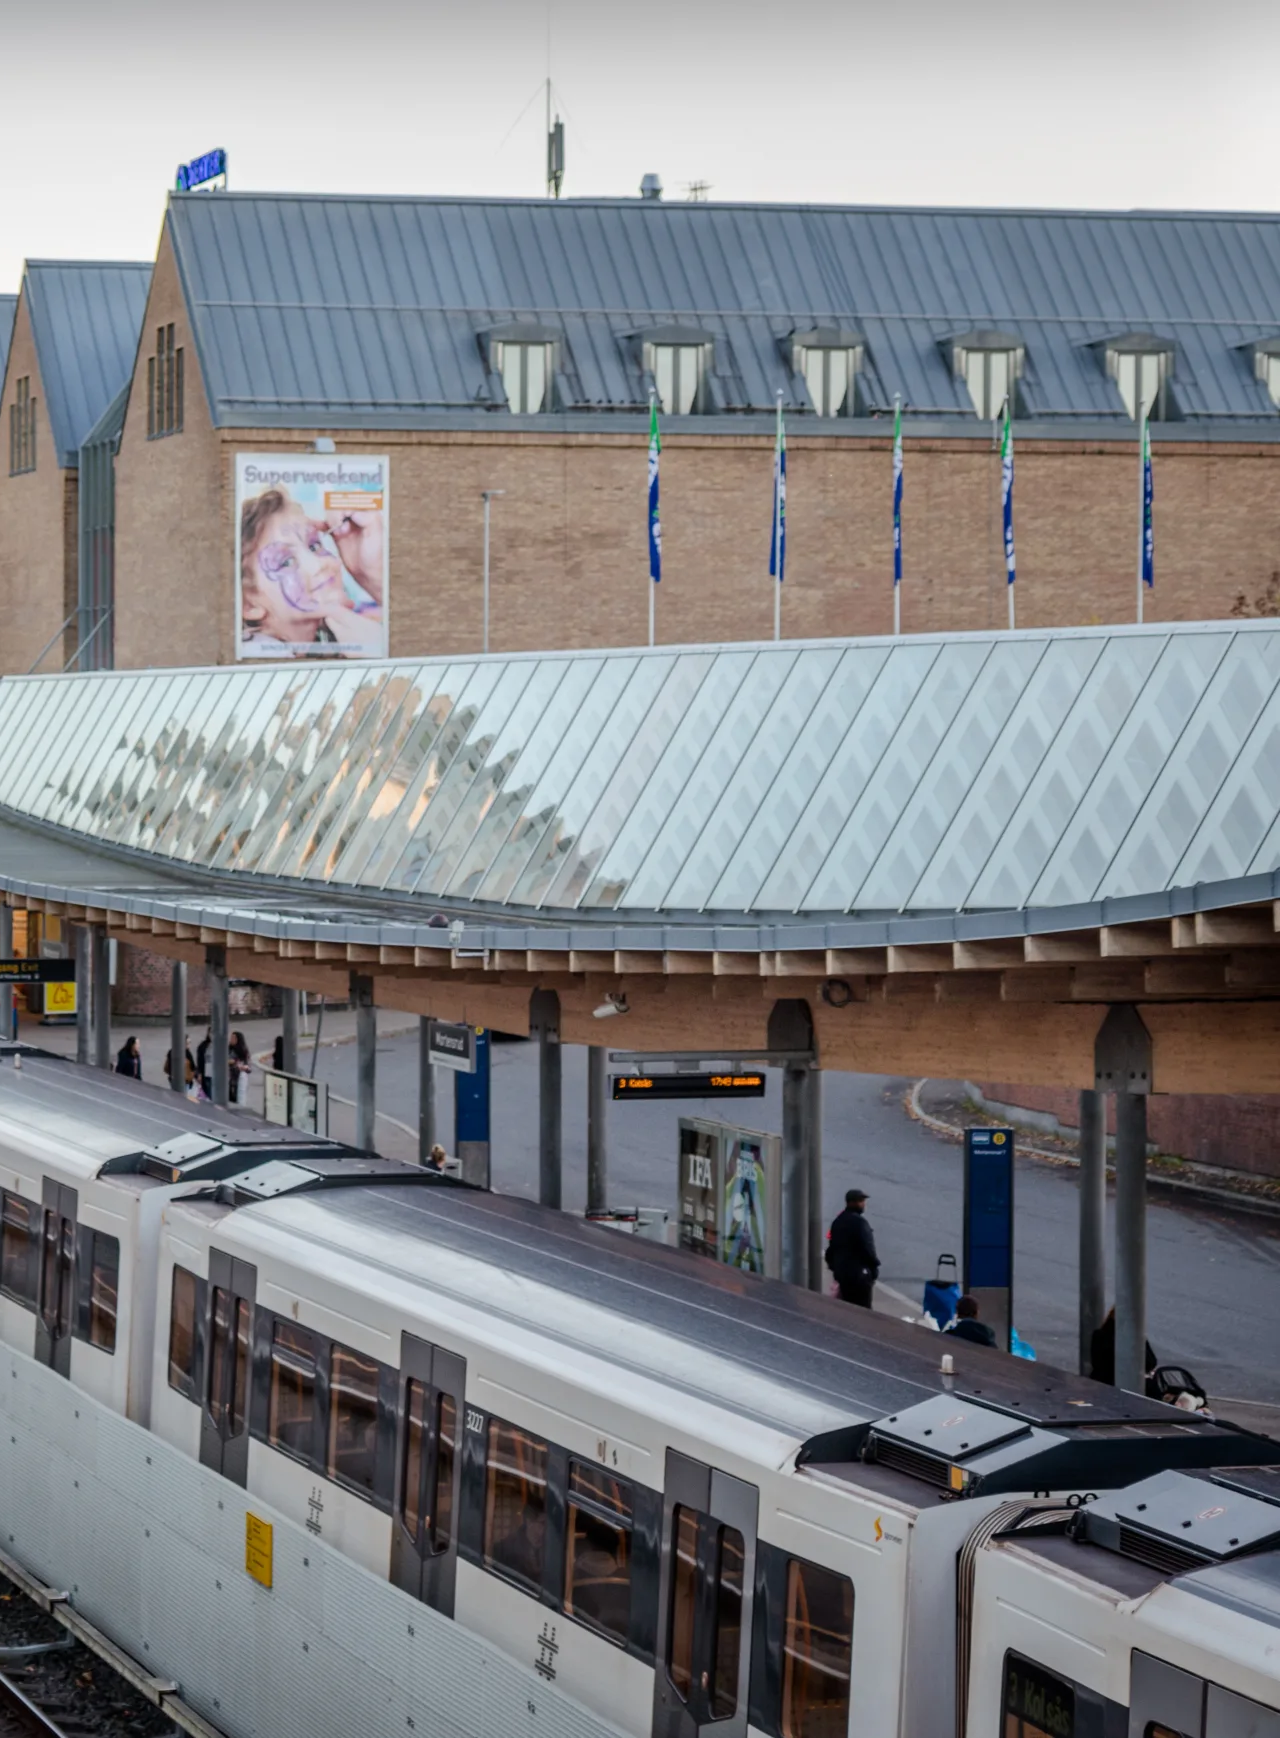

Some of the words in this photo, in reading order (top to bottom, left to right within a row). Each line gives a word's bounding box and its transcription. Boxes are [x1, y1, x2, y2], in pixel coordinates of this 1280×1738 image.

[244, 463, 382, 486] Superweekend
[21, 962, 38, 972] Exit
[688, 1154, 713, 1189] IFA
[466, 1409, 484, 1434] 3227
[1009, 1671, 1018, 1708] 3
